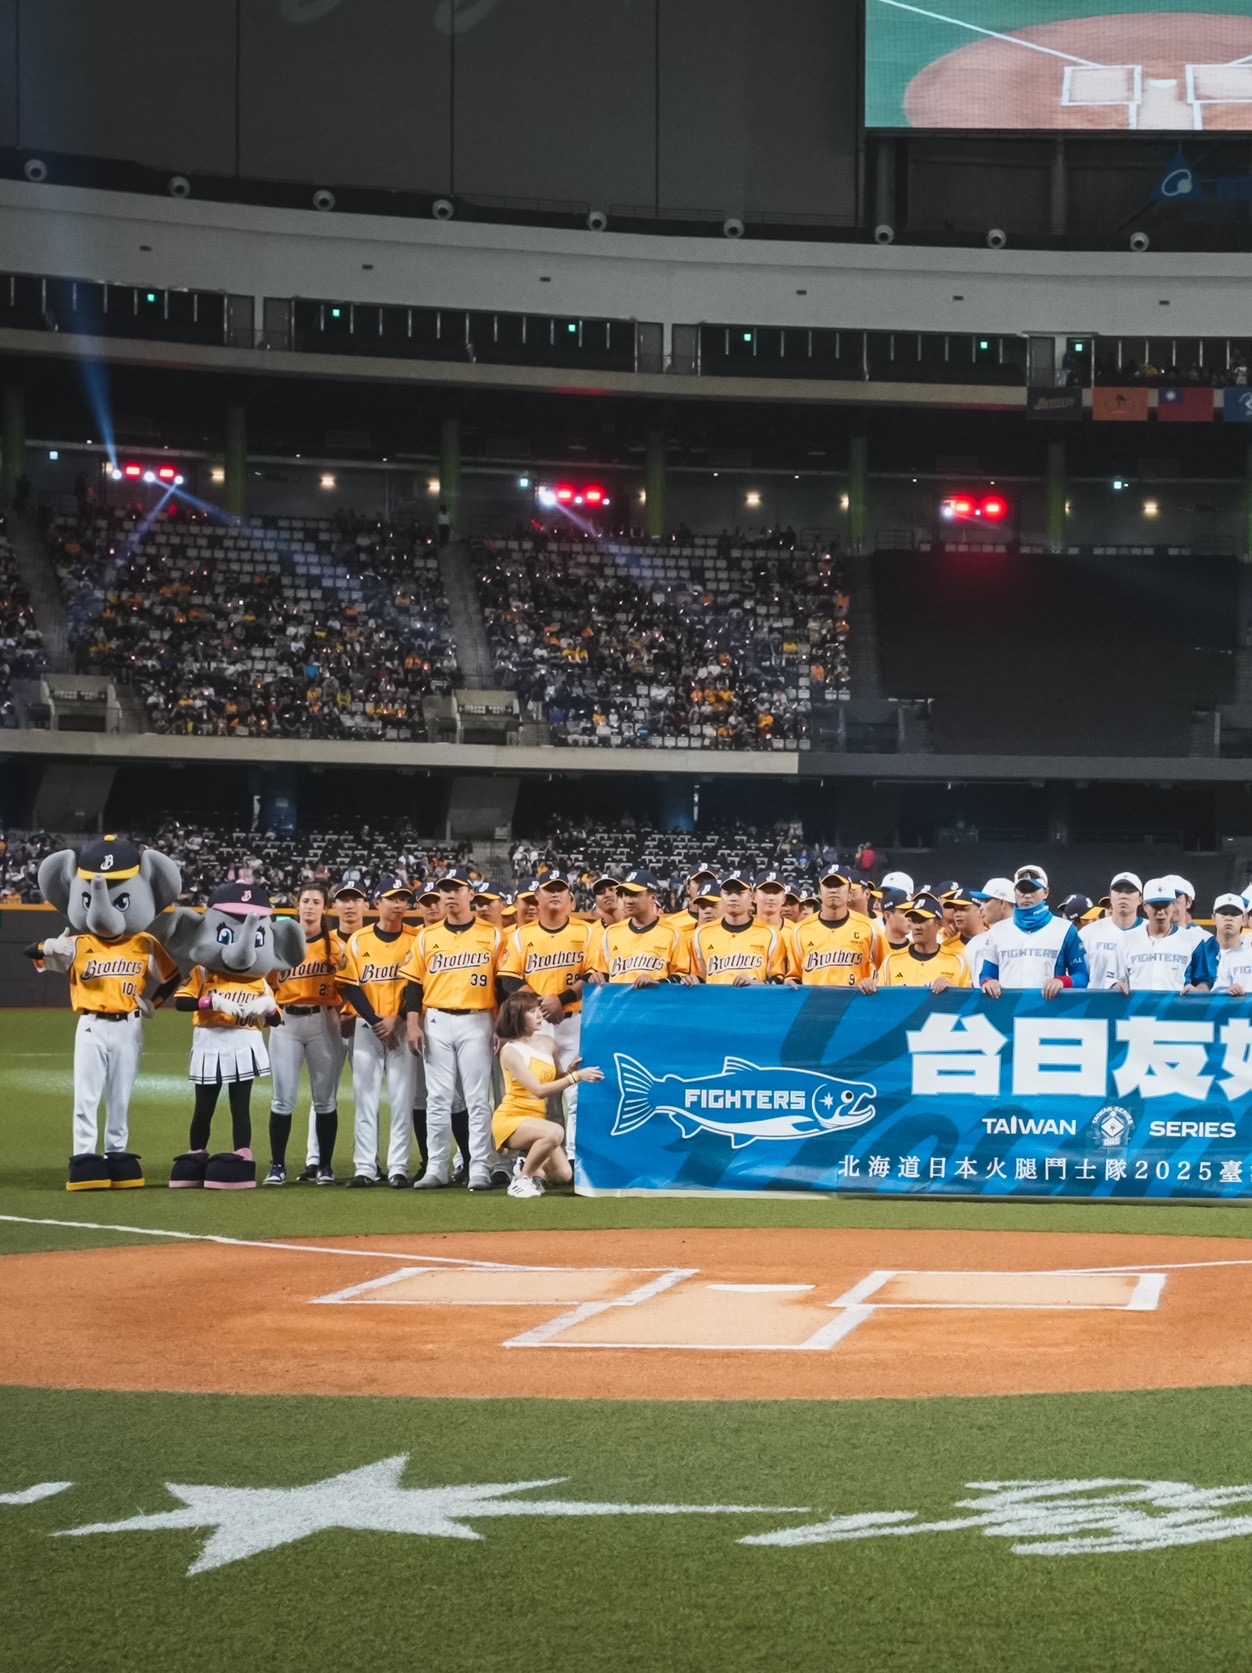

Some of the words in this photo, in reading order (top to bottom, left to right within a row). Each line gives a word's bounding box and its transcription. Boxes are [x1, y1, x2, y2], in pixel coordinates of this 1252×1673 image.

[81, 958, 142, 980] Brothers
[429, 951, 490, 974] Brothers
[524, 950, 584, 974] Brothers
[610, 954, 666, 977] Brothers
[708, 953, 763, 976] Brothers
[804, 950, 863, 972] Brothers
[470, 974, 488, 987] 39
[848, 974, 856, 985] 9
[684, 1089, 806, 1109] FIGHTERS
[982, 1115, 1076, 1135] TAIWAN
[1149, 1120, 1236, 1138] SERIES
